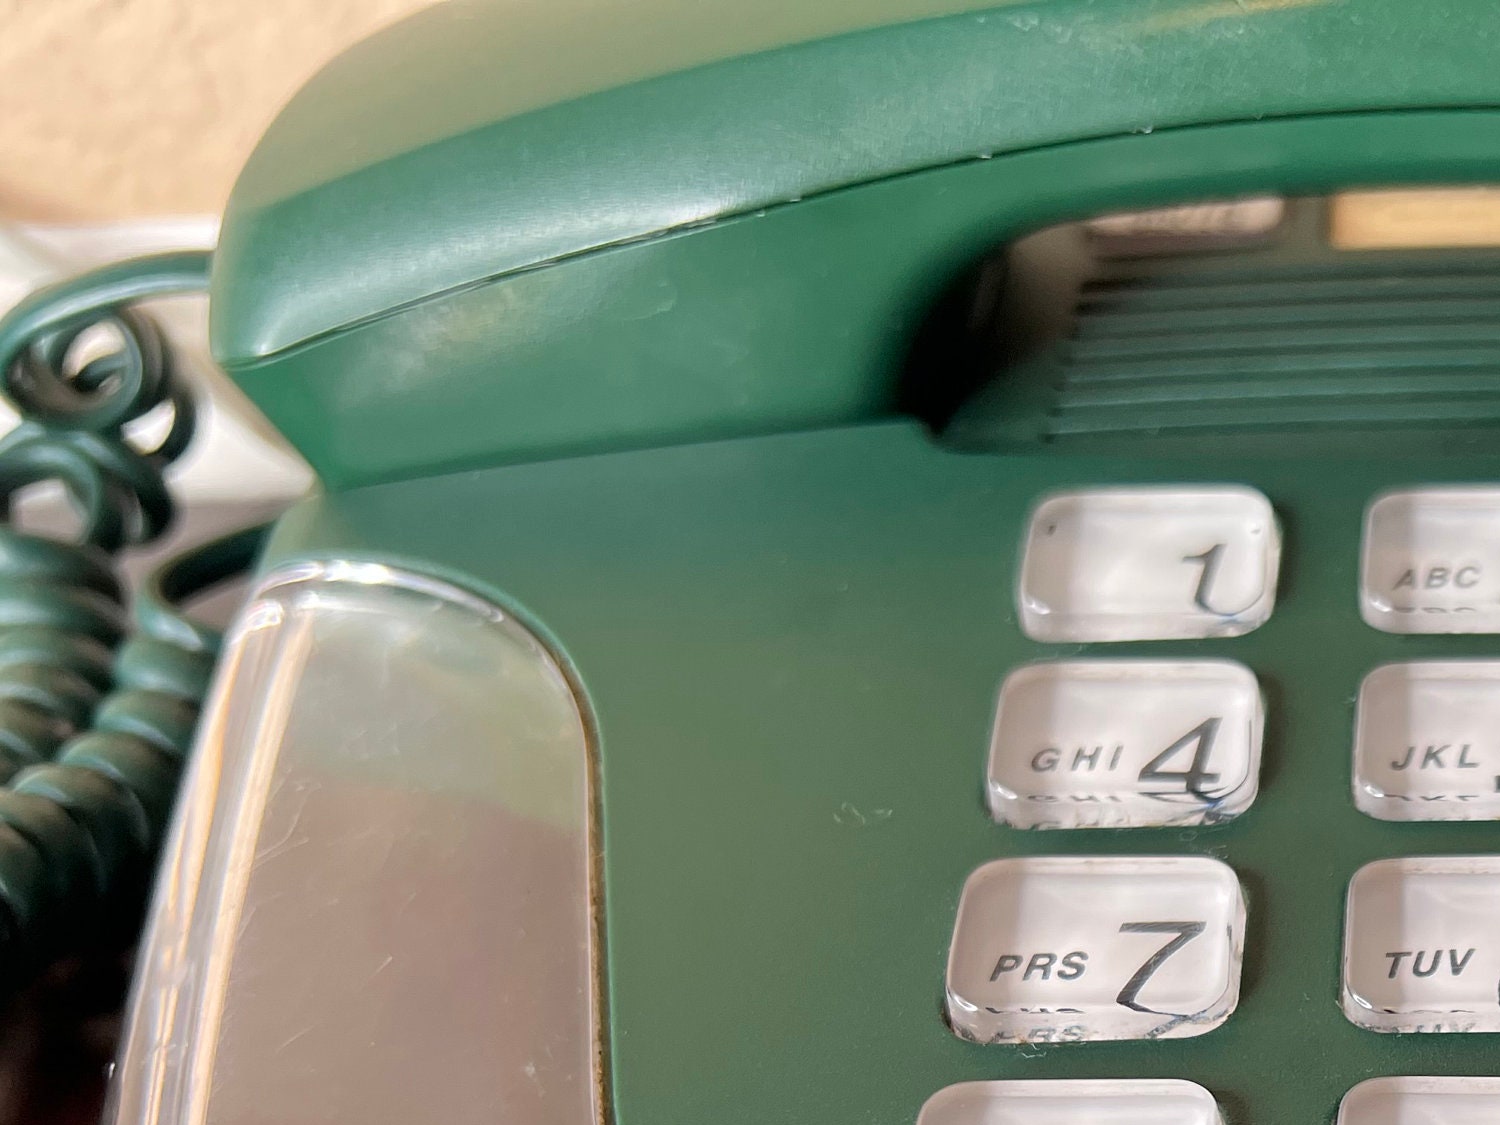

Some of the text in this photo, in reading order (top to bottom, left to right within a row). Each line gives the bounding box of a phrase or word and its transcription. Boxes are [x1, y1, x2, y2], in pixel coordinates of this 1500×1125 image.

[1182, 543, 1248, 616] 1
[1392, 565, 1480, 590] ABC
[1031, 717, 1222, 793] GHI 4
[1390, 744, 1480, 771] JKL
[990, 921, 1206, 1018] PRS 7
[1385, 947, 1476, 979] TUV
